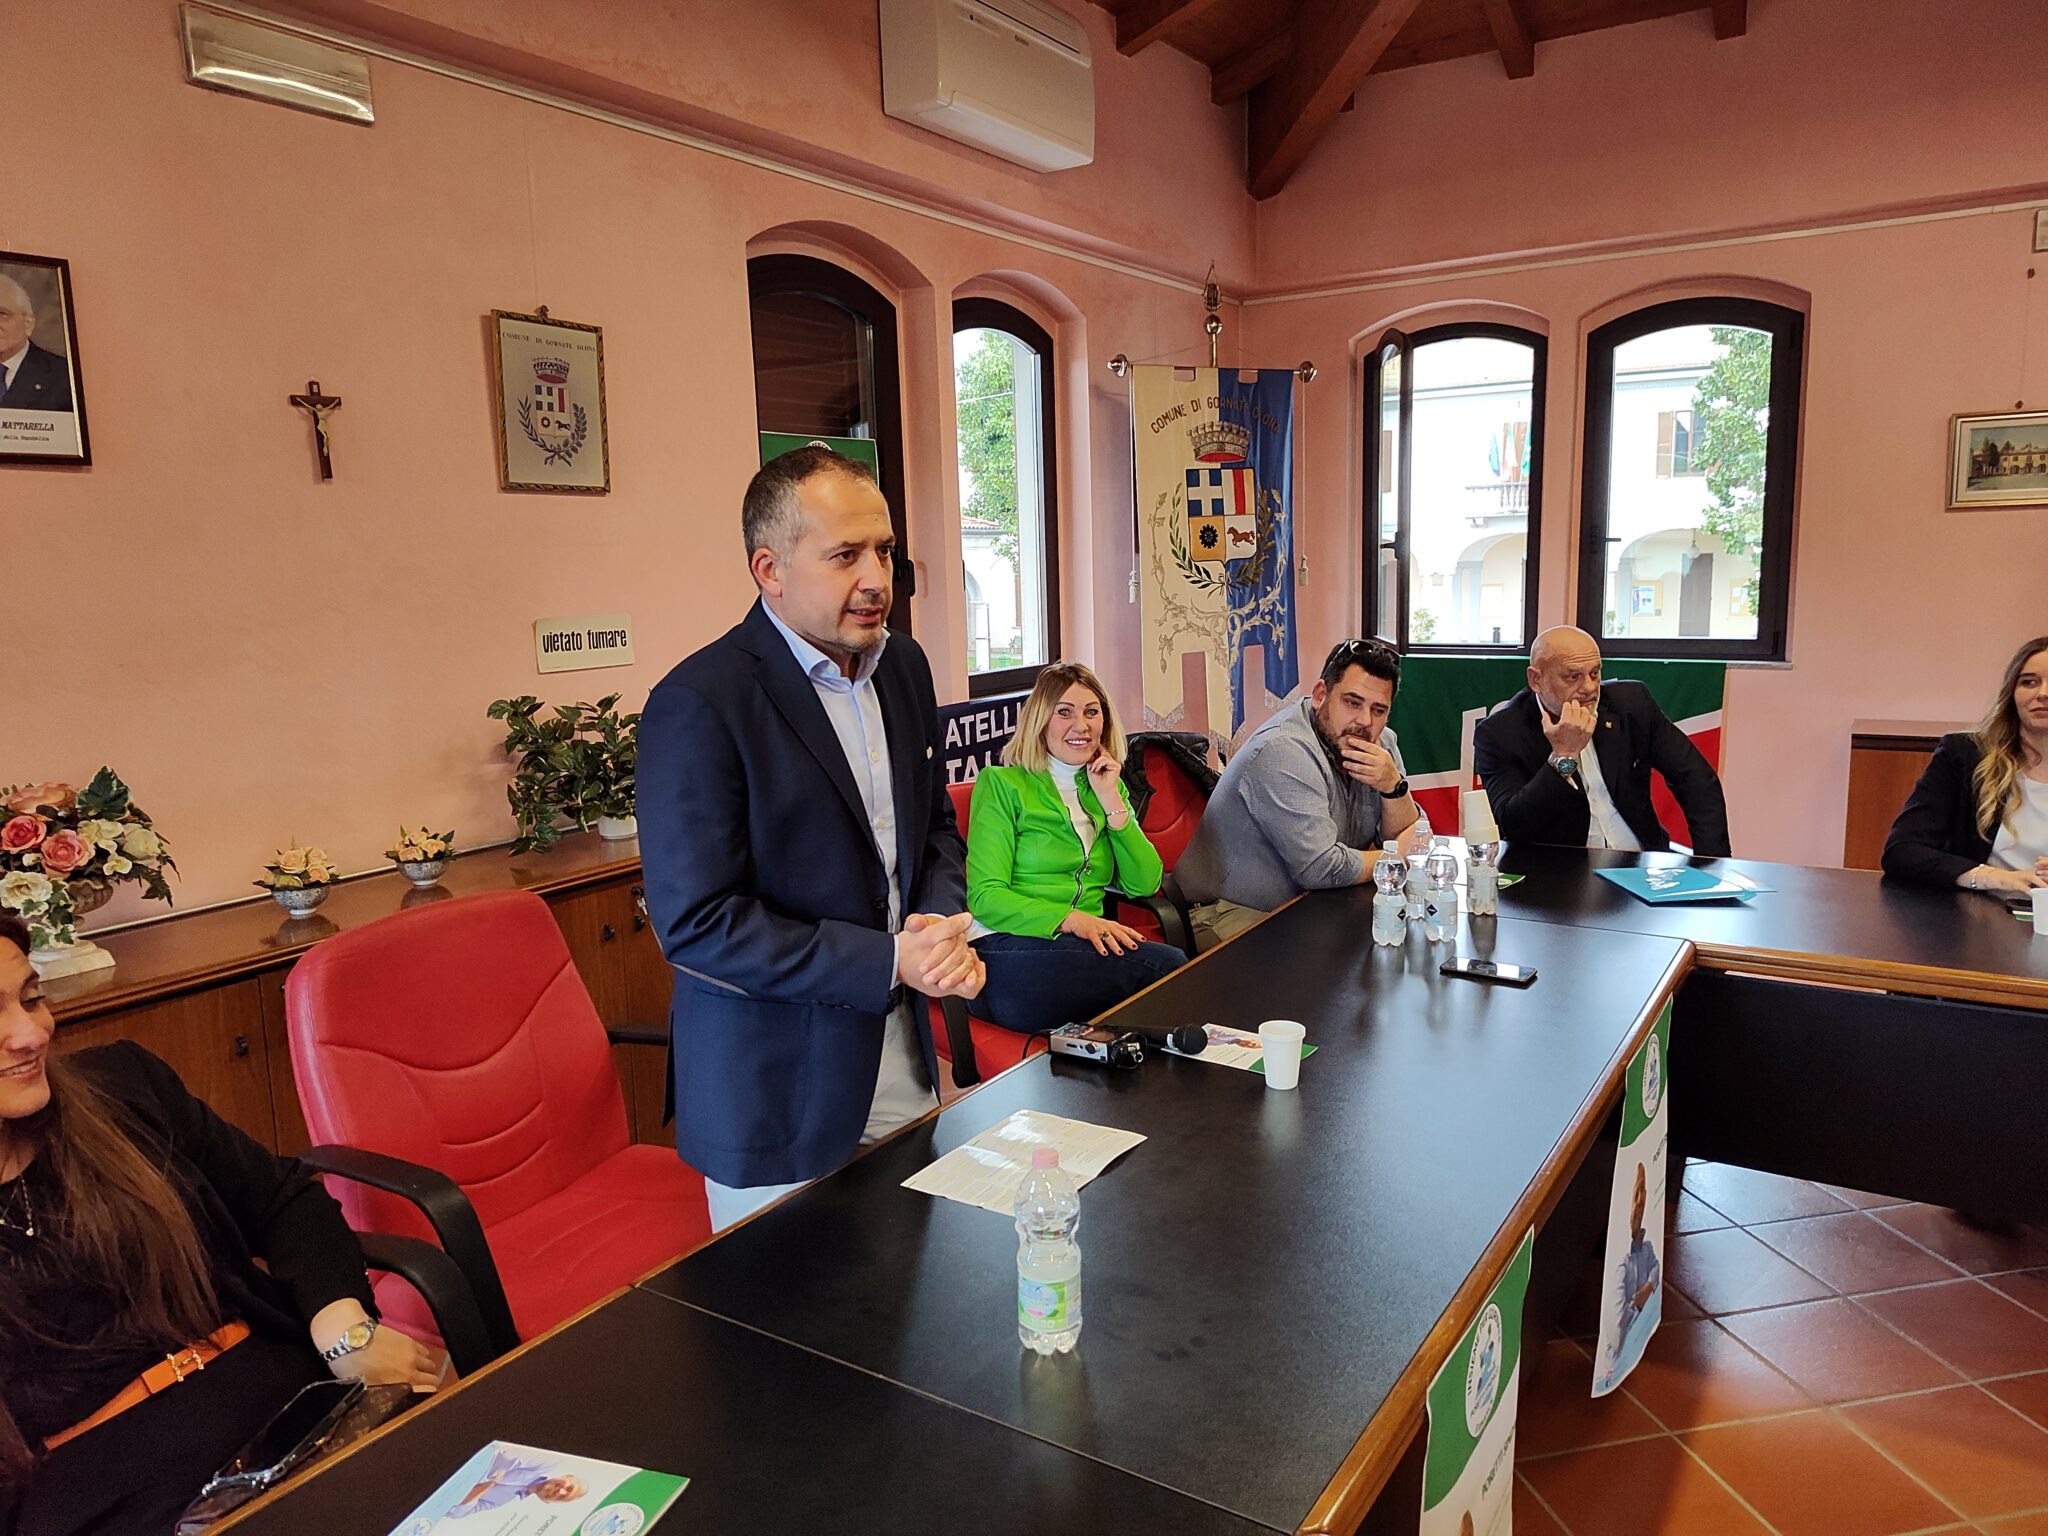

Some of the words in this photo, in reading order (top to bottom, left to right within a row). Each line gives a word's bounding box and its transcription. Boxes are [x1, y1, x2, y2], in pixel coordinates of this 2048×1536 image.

[1, 421, 55, 431] MATTARELLA
[1150, 403, 1188, 434] COMUNE
[1190, 398, 1203, 413] DI
[1207, 396, 1249, 411] GORNATE
[1252, 406, 1281, 433] OONA
[542, 631, 583, 653] vietato
[586, 629, 627, 650] fumare
[945, 702, 1021, 750] ATELLI
